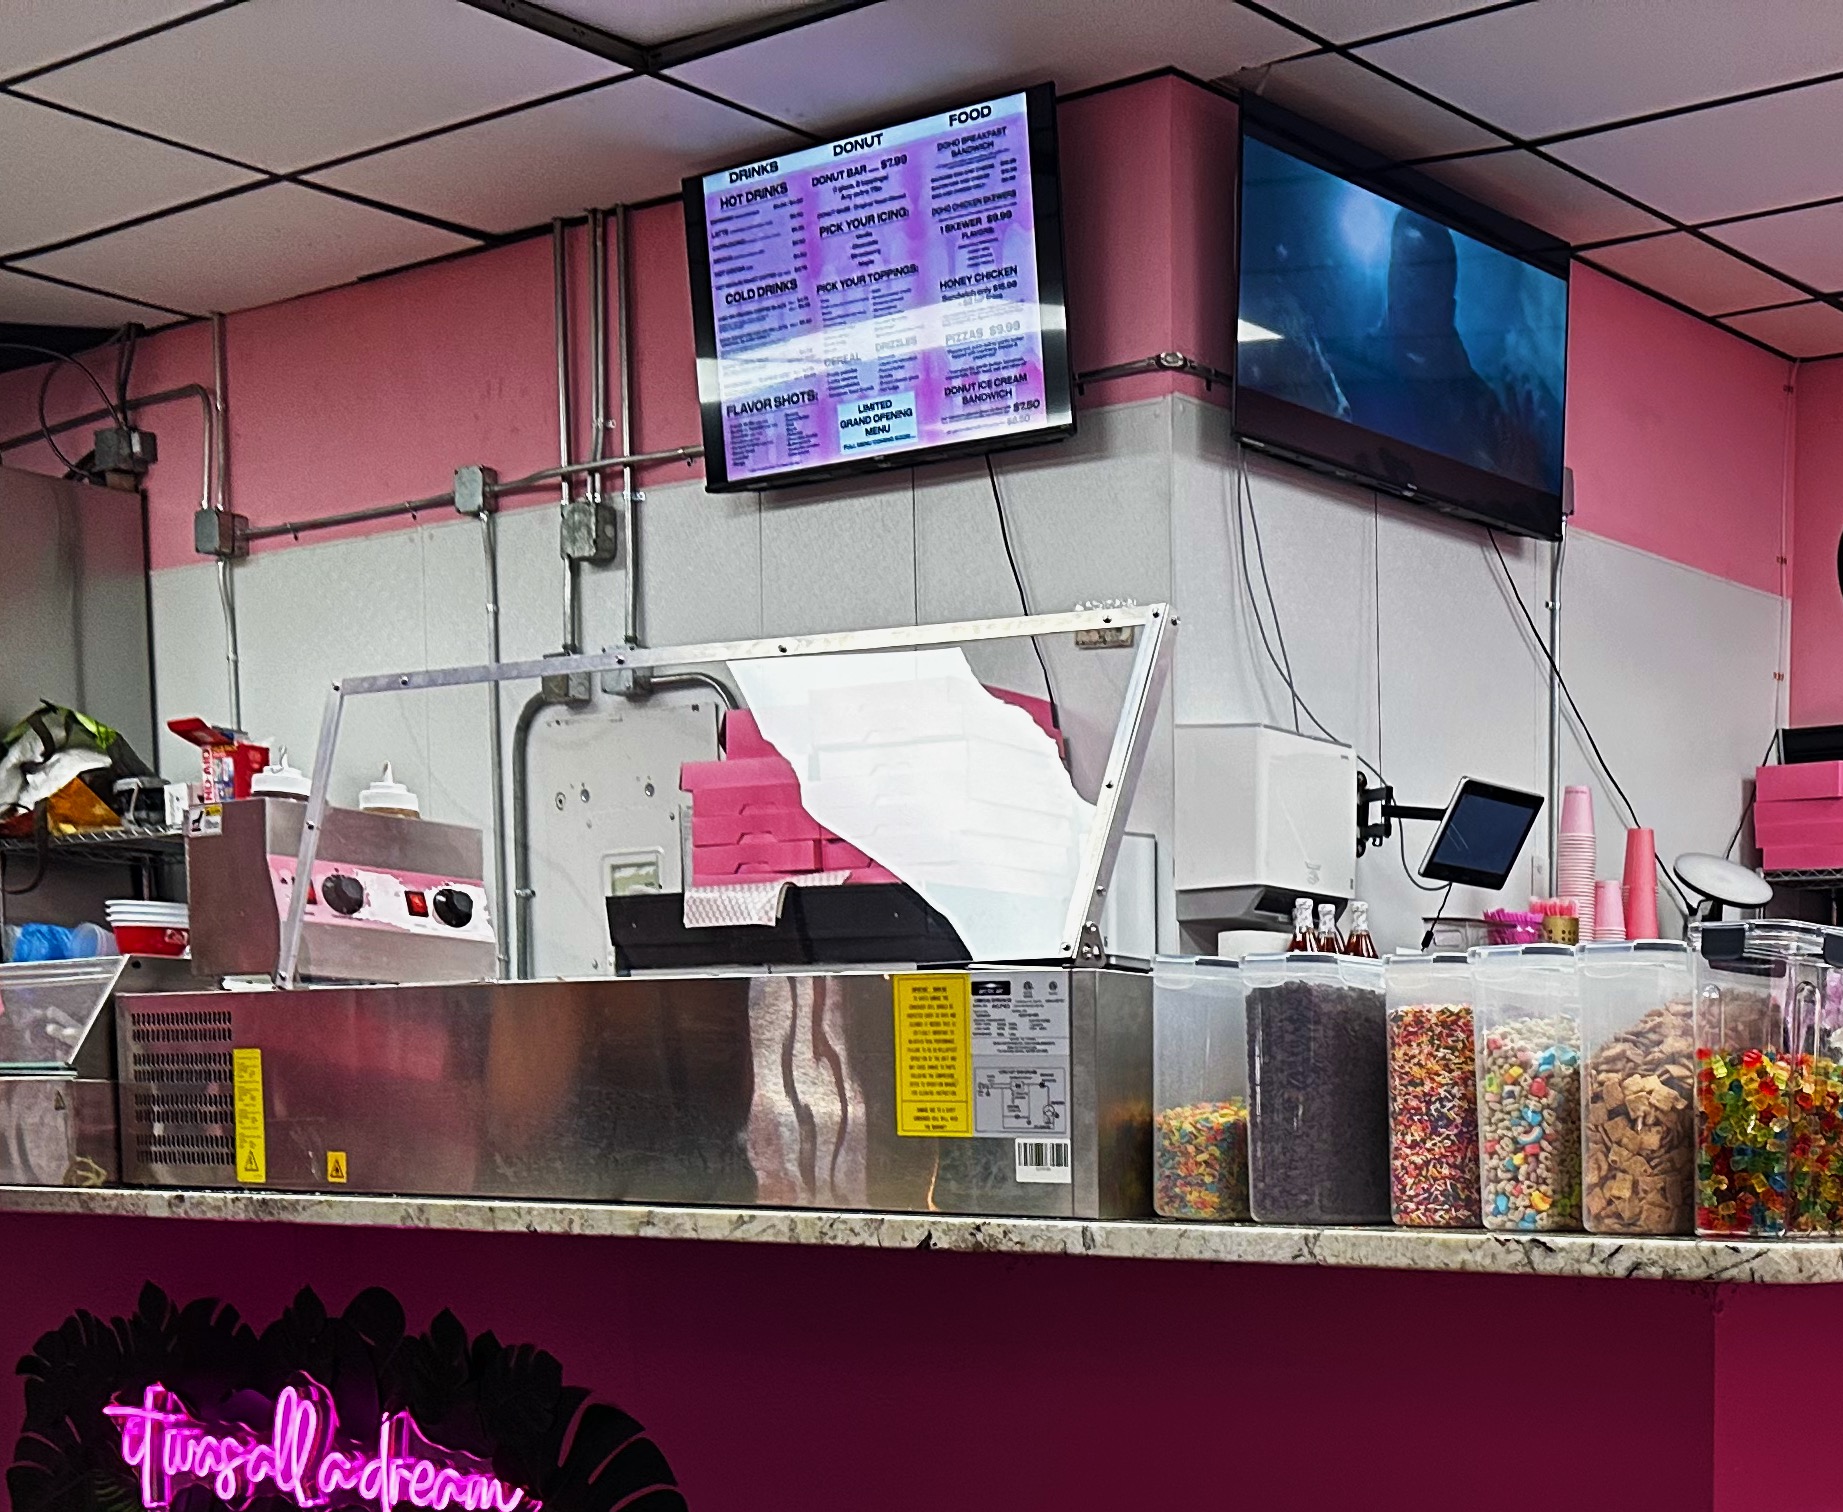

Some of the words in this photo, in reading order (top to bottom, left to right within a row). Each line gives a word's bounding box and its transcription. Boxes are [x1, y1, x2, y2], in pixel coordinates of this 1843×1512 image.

[948, 105, 992, 127] FOOD
[833, 132, 883, 157] DONUT
[729, 161, 779, 184] DRINKS
[811, 170, 845, 187] DONUT
[720, 194, 743, 210] HOT
[745, 182, 788, 203] DRINKS
[819, 222, 844, 238] PICK
[845, 214, 876, 231] YOUR
[816, 284, 839, 295] PICK
[840, 275, 866, 288] YOUR
[940, 275, 973, 290] HONEY
[974, 265, 1018, 283] CHICKEN
[725, 289, 756, 305] COLD
[757, 279, 798, 298] DRINKS
[945, 328, 984, 346] PIZZAS
[944, 382, 976, 397] DONUT
[978, 379, 993, 389] ICE
[994, 372, 1028, 387] CREAM
[858, 400, 893, 414] LIMITED
[962, 388, 1013, 406] SANDWICH
[726, 398, 773, 418] FLAVOR
[840, 416, 872, 429] GRAND
[873, 408, 913, 423] OPENING
[865, 424, 891, 437] MENU
